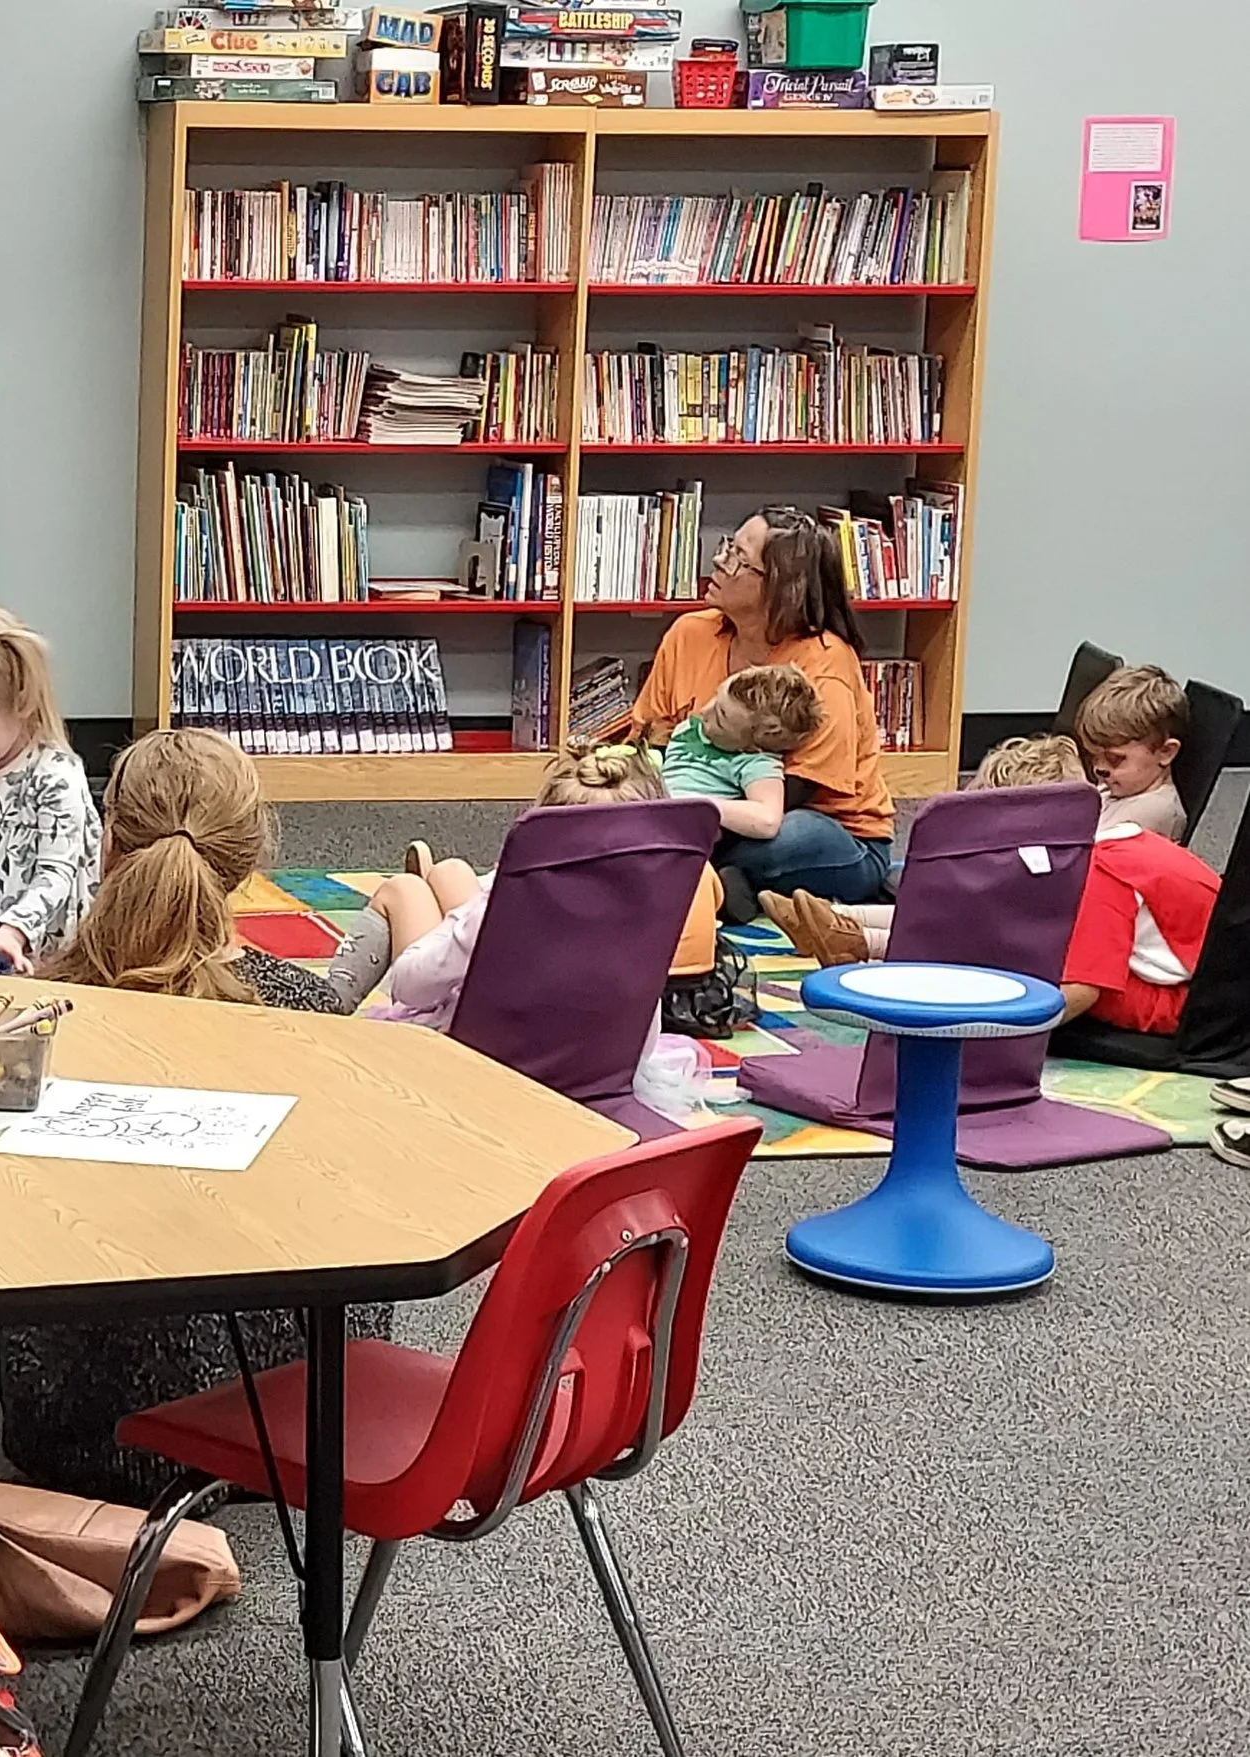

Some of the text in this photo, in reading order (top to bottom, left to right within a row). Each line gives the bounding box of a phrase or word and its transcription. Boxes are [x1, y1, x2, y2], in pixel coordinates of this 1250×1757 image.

[376, 14, 435, 46] MAD
[558, 10, 634, 30] BATTLESHIP
[210, 32, 259, 51] Clue
[480, 35, 496, 91] SECONDS
[763, 73, 808, 94] Trivial
[171, 644, 443, 685] WORLD BOOK
